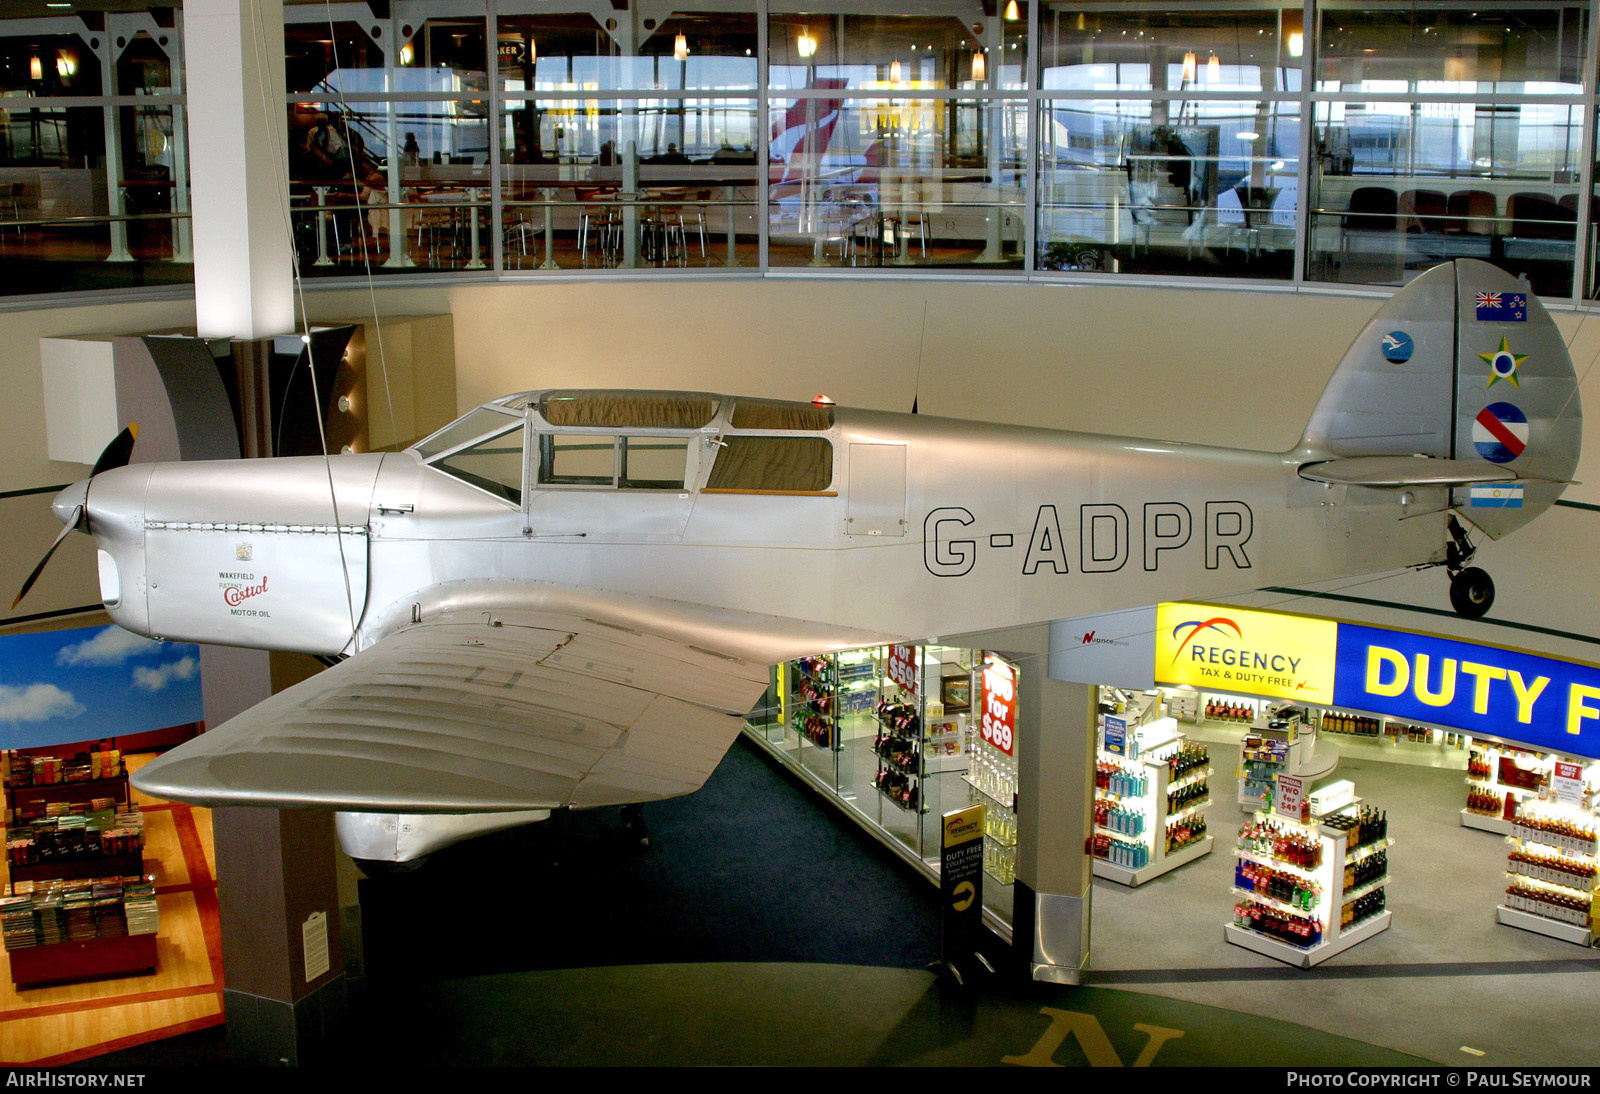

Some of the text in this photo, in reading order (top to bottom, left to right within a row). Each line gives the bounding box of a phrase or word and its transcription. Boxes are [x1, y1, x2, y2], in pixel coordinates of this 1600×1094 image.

[924, 501, 1253, 577] G-ADPR
[219, 572, 254, 580] WAKEFIELD
[224, 576, 269, 607] Castrol
[230, 609, 271, 618] MOTOR OIL
[1191, 644, 1302, 675] REGENCY
[889, 655, 914, 690] $59
[1200, 667, 1221, 679] TAX
[1223, 670, 1233, 680] &
[1235, 671, 1266, 684] DUTY
[1267, 676, 1294, 688] FREE
[1365, 645, 1600, 736] DUTY F
[986, 692, 1009, 722] for
[982, 712, 1013, 752] $69
[1560, 764, 1577, 773] FREE
[1561, 769, 1577, 778] GIFT
[1280, 777, 1301, 787] SPECIAL
[1280, 784, 1299, 796] TWO
[1280, 802, 1298, 812] $49
[1283, 794, 1296, 804] for
[950, 822, 978, 836] REGENCY
[946, 844, 983, 862] DUTY FREE
